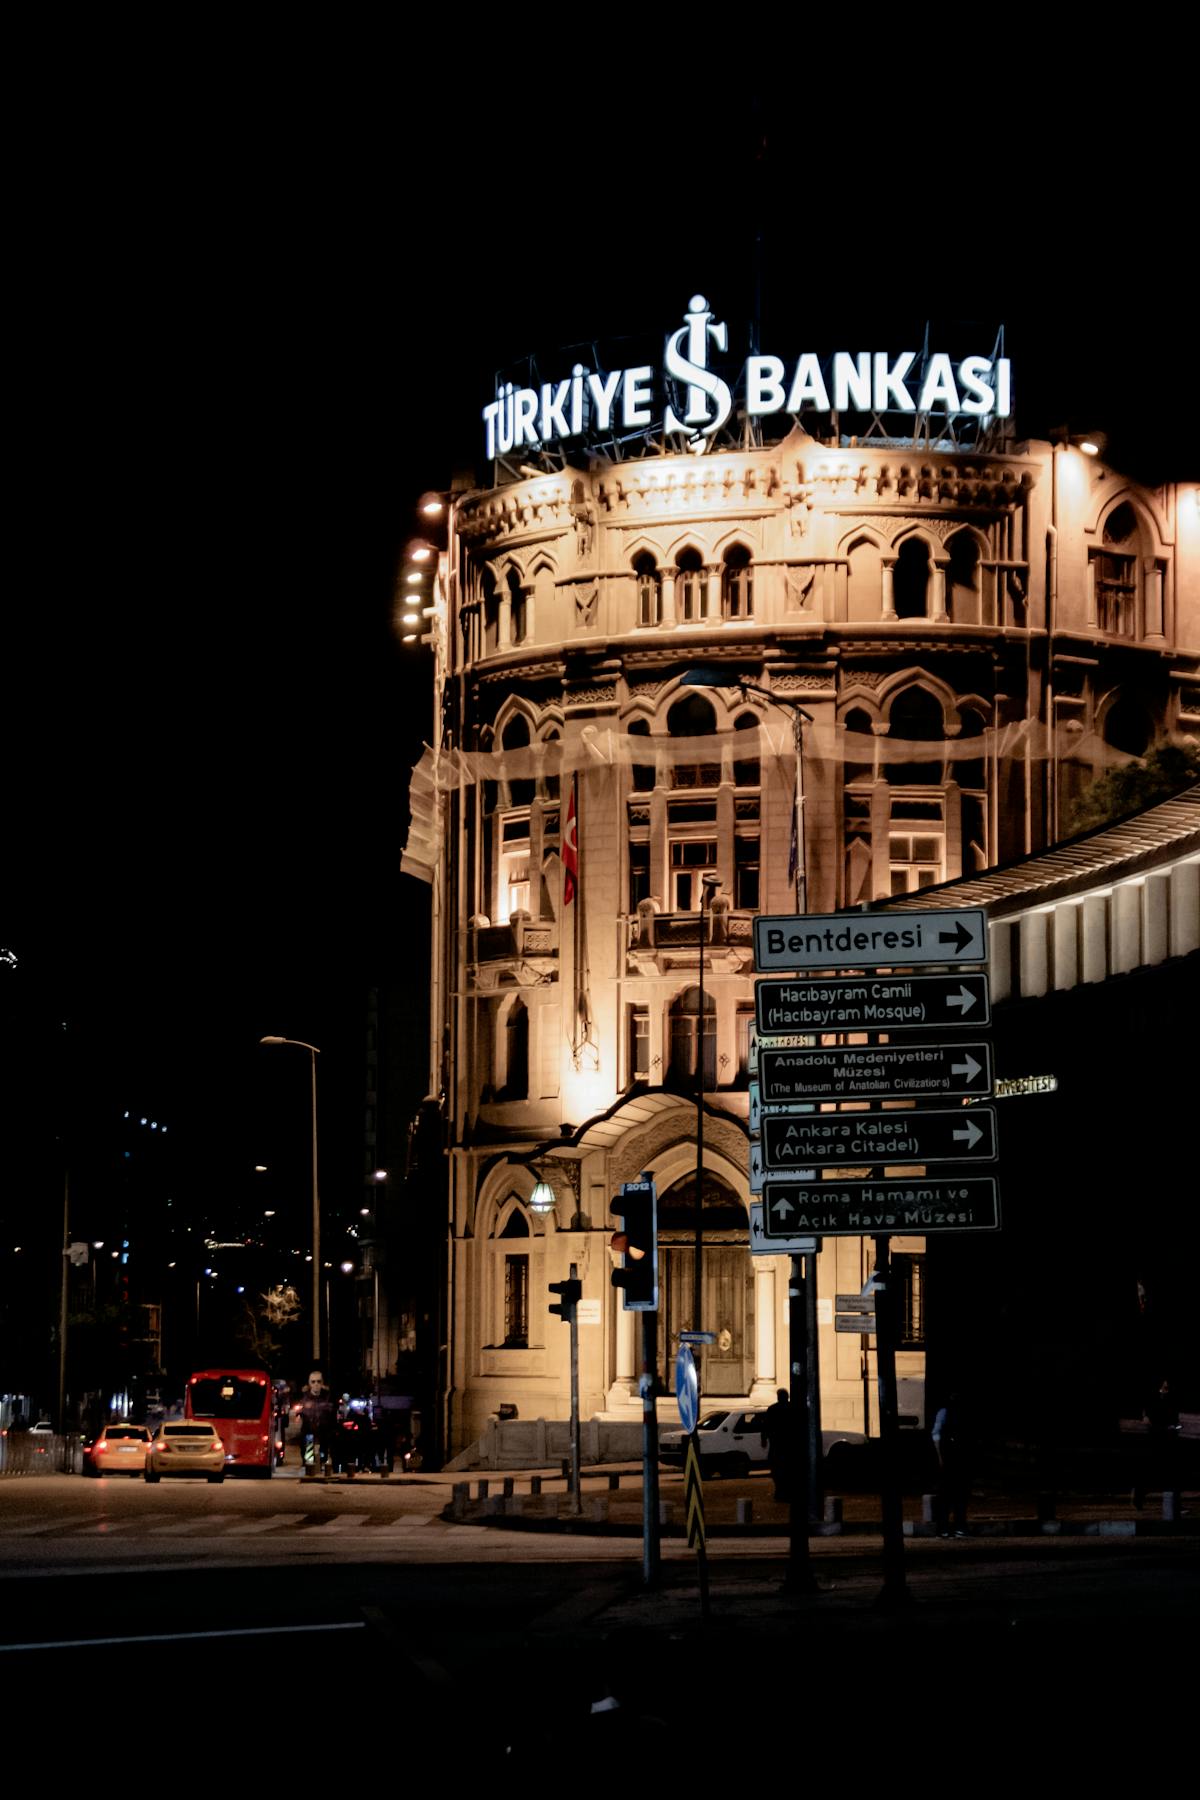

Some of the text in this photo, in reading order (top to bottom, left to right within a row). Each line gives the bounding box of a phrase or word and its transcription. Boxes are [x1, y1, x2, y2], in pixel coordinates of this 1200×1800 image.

[482, 362, 653, 461] TÜRKİYE
[746, 350, 1011, 417] BANKASI
[767, 925, 922, 954] Bentderesi
[780, 983, 912, 1005] Hacıbayram Camii
[768, 1003, 926, 1027] (Hacıbayram Mosque)
[775, 1050, 944, 1067] Anadolu Medeniyetleri
[833, 1066, 885, 1078] Müzesi
[770, 1082, 791, 1095] (The
[794, 1081, 832, 1093] Museum
[835, 1081, 845, 1091] of
[849, 1080, 891, 1091] Anatolian
[786, 1120, 908, 1138] Ankara Kalesi
[774, 1138, 919, 1160] (Ankara Citadel)
[798, 1188, 969, 1205] Roma Hamamı ve
[798, 1208, 974, 1229] Açık Hava Müzesi
